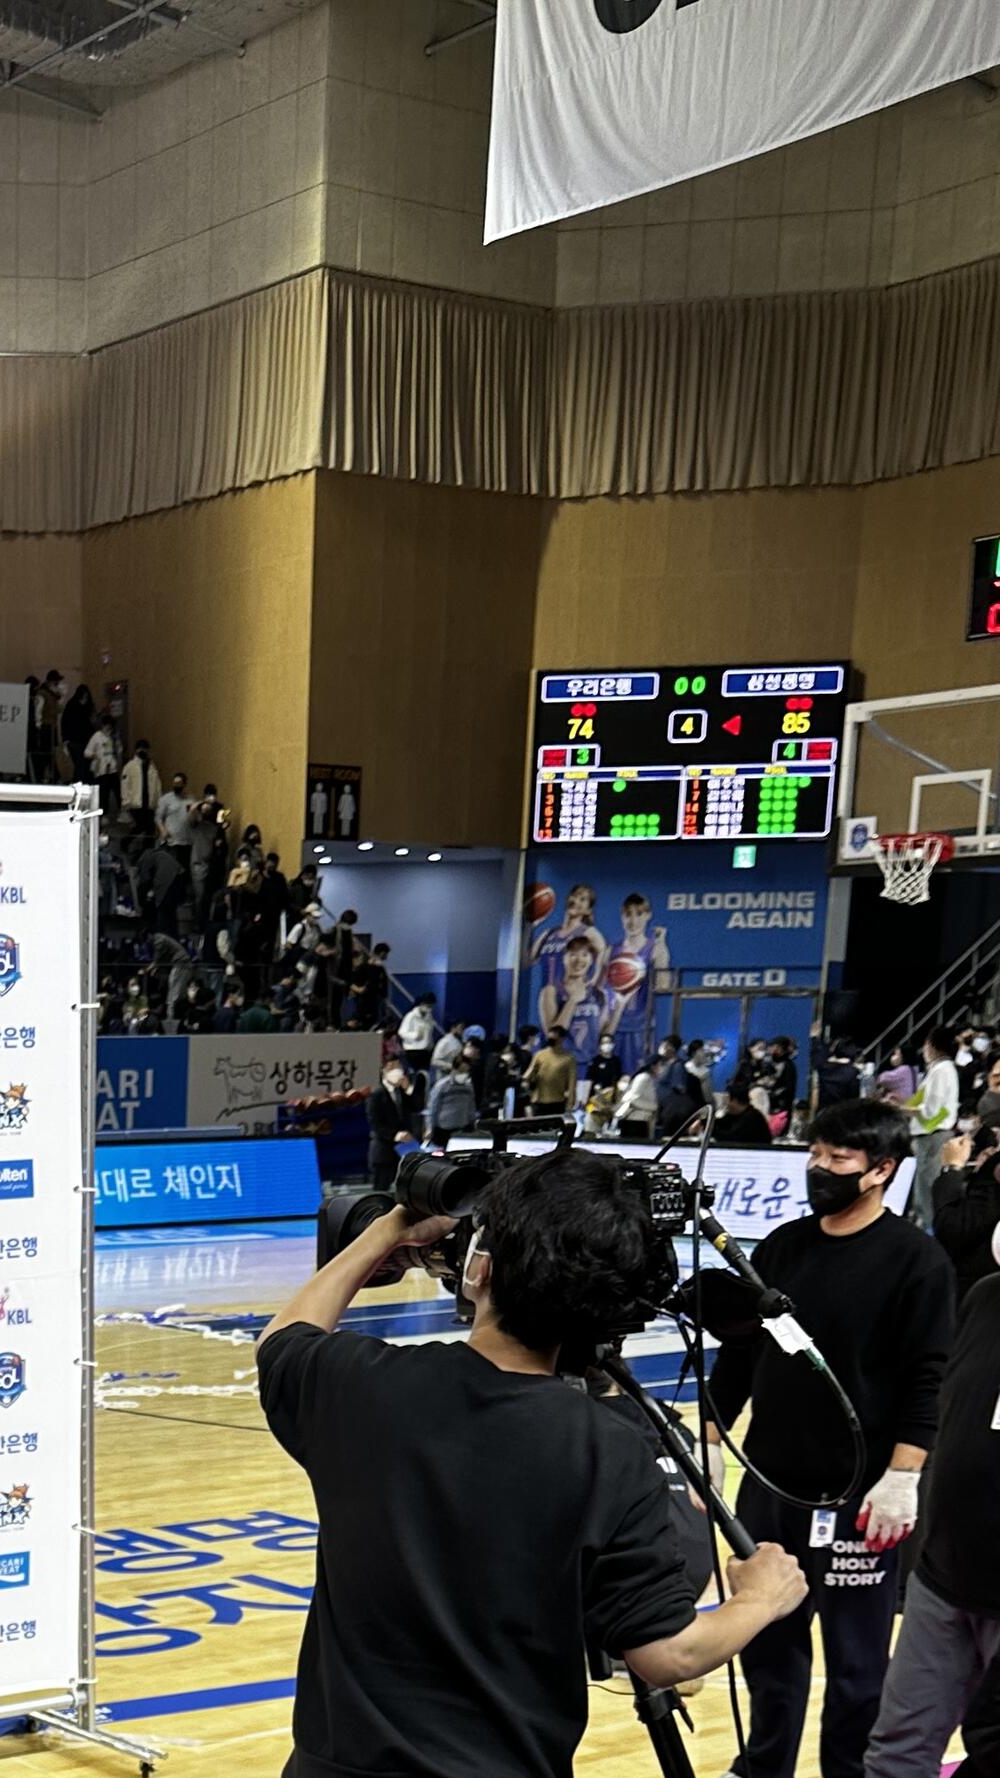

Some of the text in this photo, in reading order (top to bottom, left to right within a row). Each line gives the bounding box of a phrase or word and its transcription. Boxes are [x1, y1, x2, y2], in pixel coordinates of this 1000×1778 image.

[567, 718, 595, 740] 74
[681, 717, 694, 735] 4
[782, 711, 811, 734] 85
[576, 747, 590, 765] 3
[782, 742, 796, 759] 4
[667, 891, 816, 911] BLOOMING
[727, 911, 814, 929] AGAIN
[703, 969, 787, 988] GATE D
[96, 1067, 155, 1099] ARI
[270, 1058, 358, 1096] 상하목장
[97, 1101, 141, 1131] AT
[94, 1161, 243, 1204] 대로 체인지
[831, 1540, 869, 1554] ONL
[831, 1556, 880, 1571] HOLY
[823, 1570, 887, 1587] STORY
